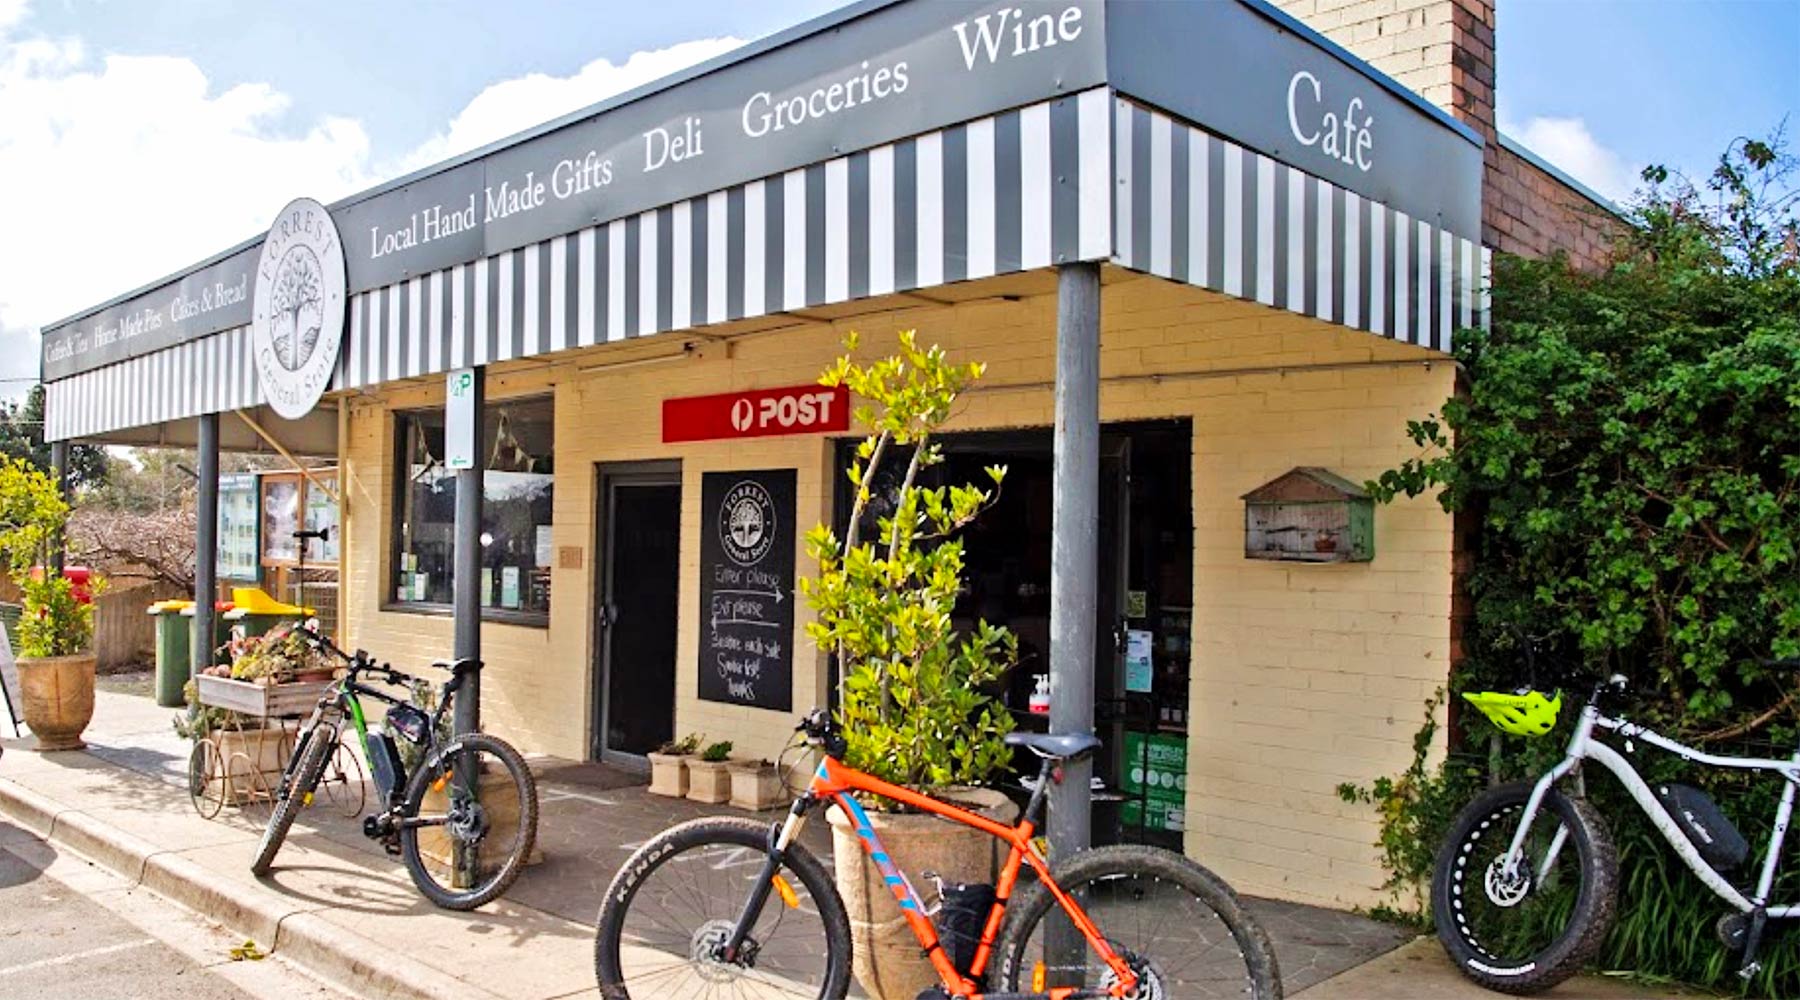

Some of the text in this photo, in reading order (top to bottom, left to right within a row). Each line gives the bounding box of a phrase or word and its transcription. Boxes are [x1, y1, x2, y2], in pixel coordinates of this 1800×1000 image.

[370, 5, 1083, 259] Local Hand Made Gifts Deli Groceries Wine
[1287, 70, 1374, 172] Café
[261, 209, 334, 282] FORREST
[118, 311, 143, 340] Made
[171, 295, 200, 322] Cakes
[201, 287, 214, 313] &
[215, 272, 248, 309] Bread
[260, 337, 334, 405] General Store
[759, 391, 835, 428] POST
[617, 843, 674, 903] KENDA
